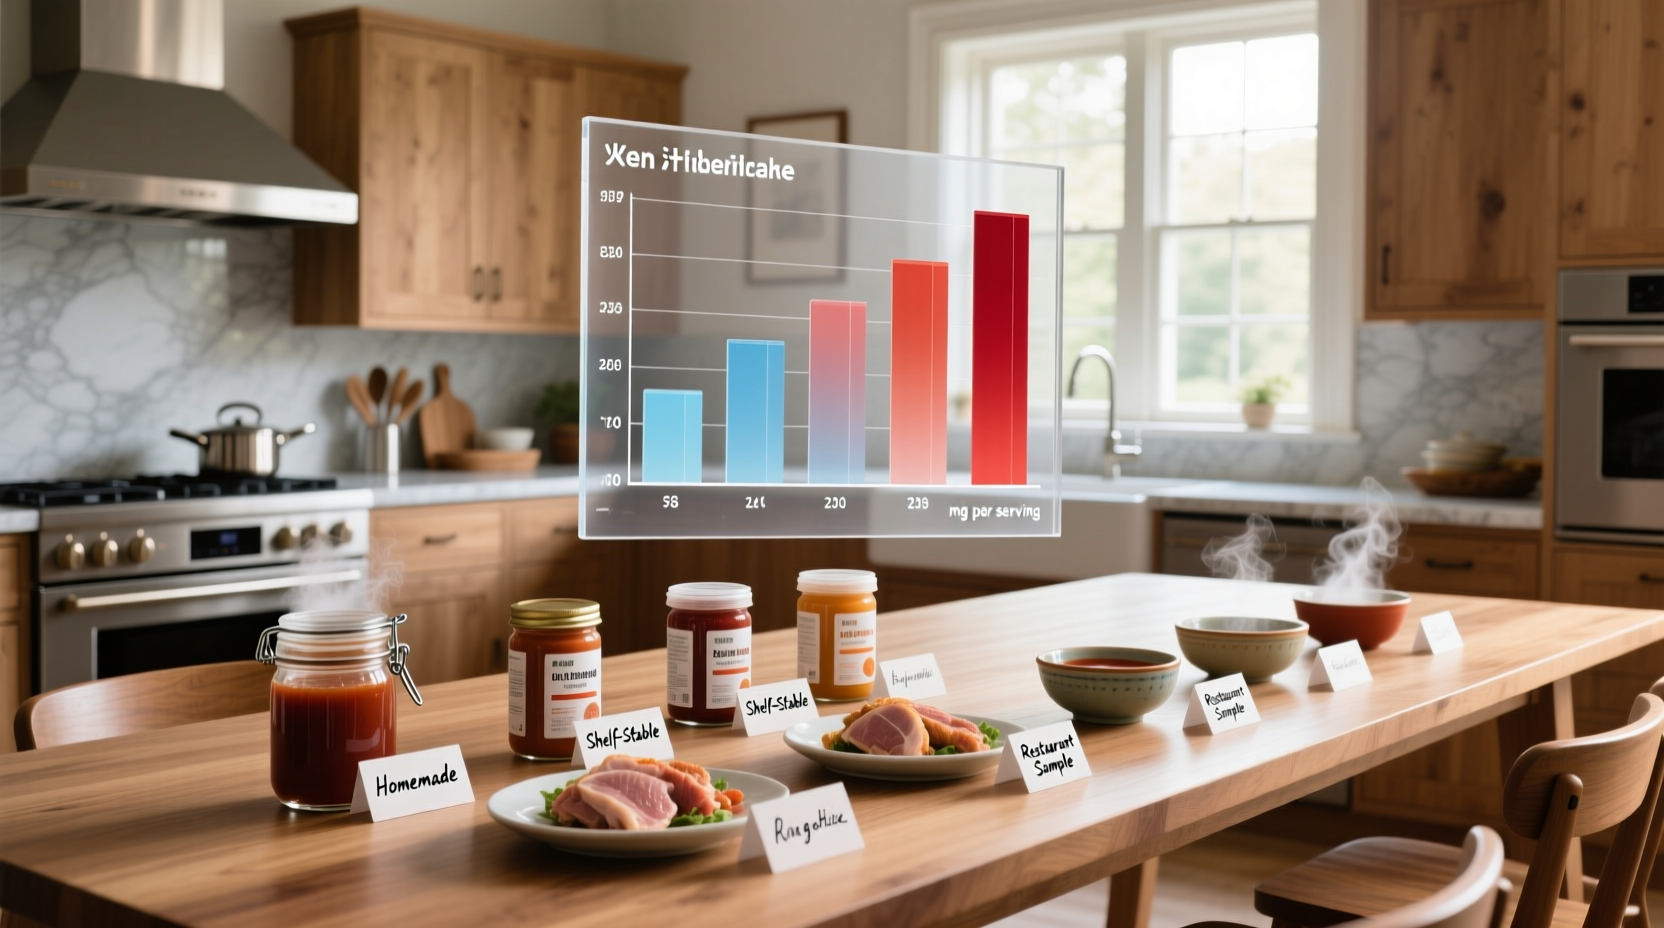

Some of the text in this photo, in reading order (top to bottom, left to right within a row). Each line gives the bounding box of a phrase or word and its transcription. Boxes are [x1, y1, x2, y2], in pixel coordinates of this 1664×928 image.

[949, 505, 969, 522] mg
[995, 503, 1042, 522] serving
[586, 721, 660, 750] Shelf-Stable
[1034, 752, 1074, 777] Sample
[376, 762, 458, 797] Homemade
